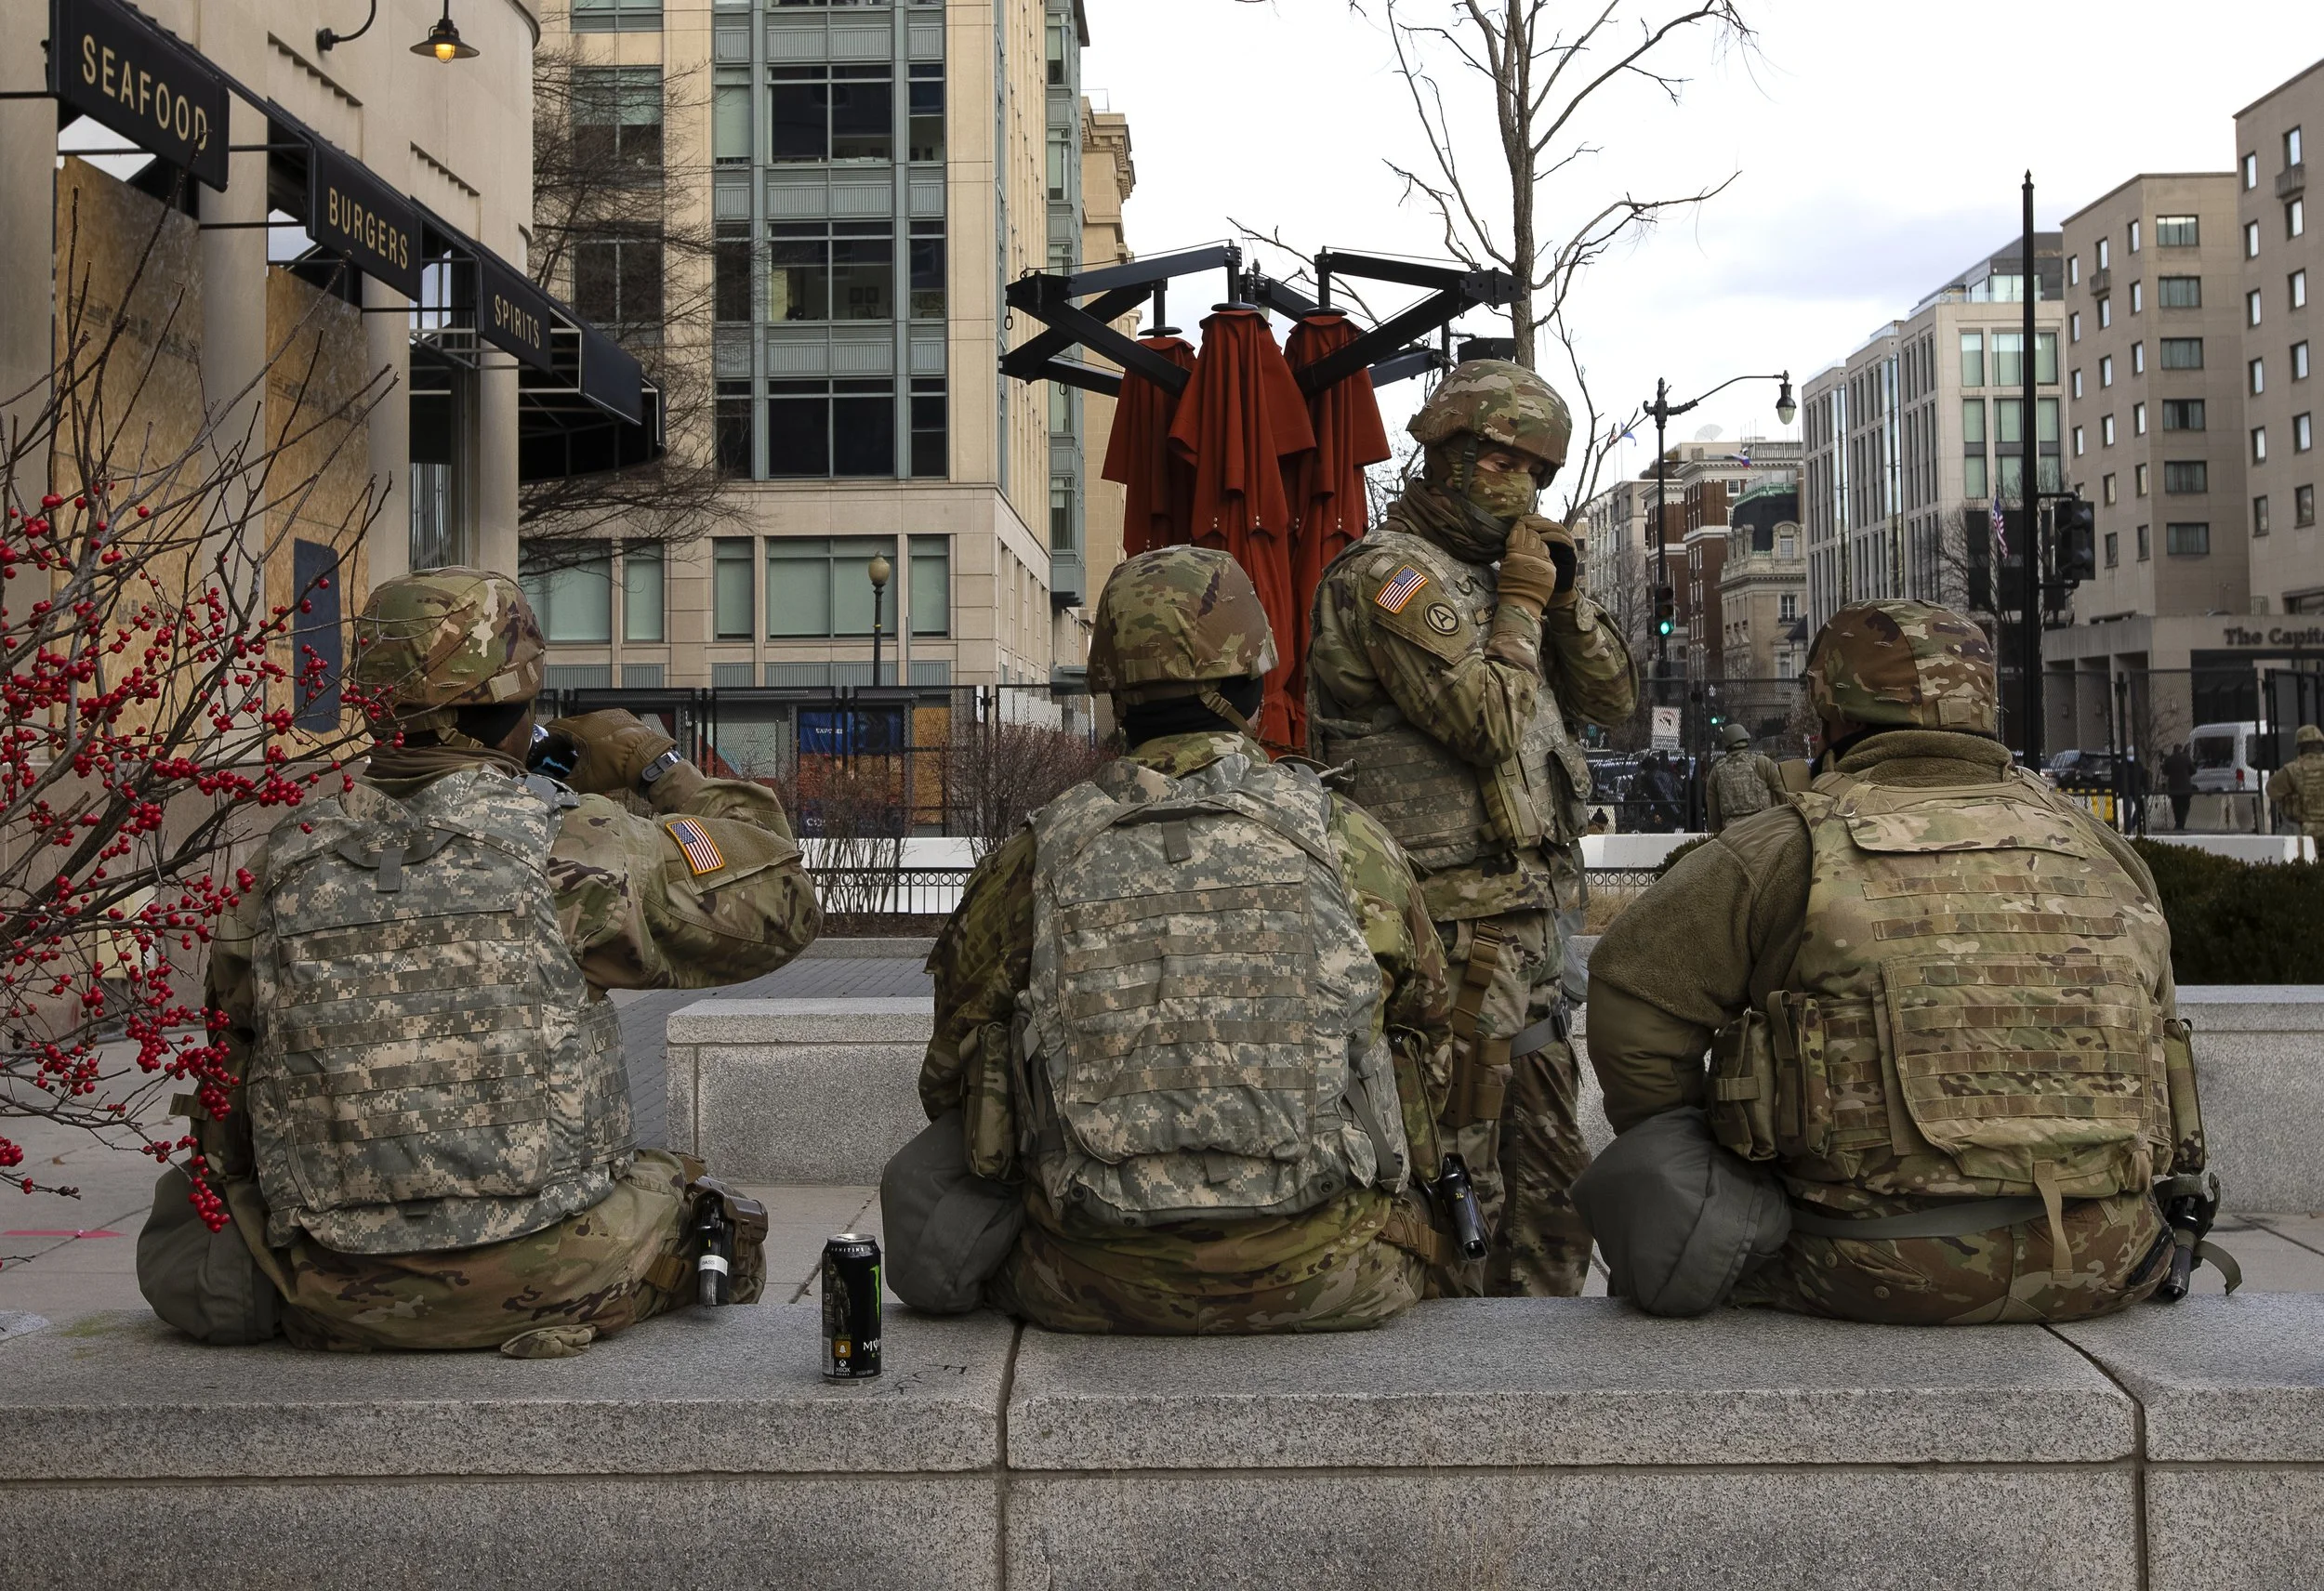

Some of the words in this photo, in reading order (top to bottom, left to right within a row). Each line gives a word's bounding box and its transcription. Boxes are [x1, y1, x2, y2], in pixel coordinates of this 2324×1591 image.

[83, 34, 207, 151] SEAFOOD
[329, 187, 408, 270] BURGERS
[495, 294, 540, 349] SPIRITS
[1433, 609, 1454, 628] A
[2224, 626, 2263, 646] The
[2268, 627, 2324, 650] Capit
